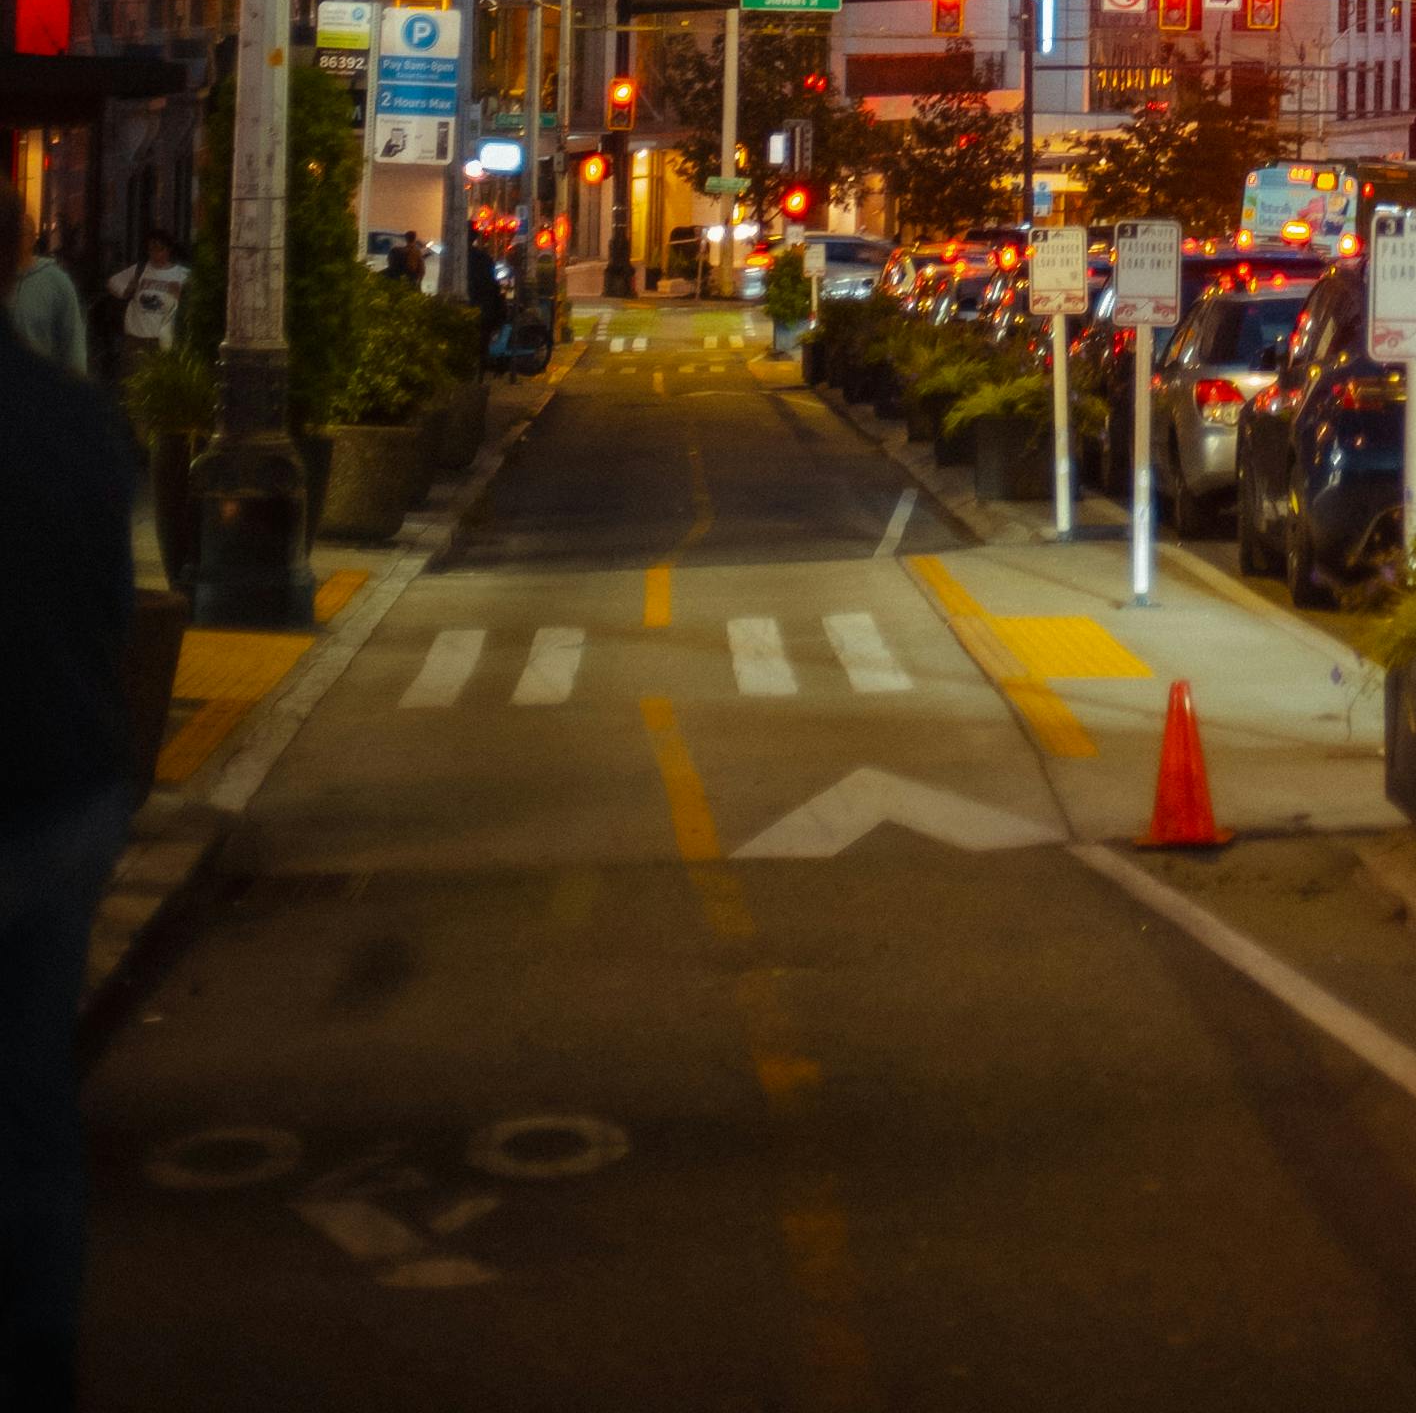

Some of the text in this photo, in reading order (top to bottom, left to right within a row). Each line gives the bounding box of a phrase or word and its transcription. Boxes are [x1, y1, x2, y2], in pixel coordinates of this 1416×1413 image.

[320, 55, 365, 70] 86392
[383, 59, 401, 71] Pay
[381, 92, 451, 110] 2 Hours Max
[1121, 243, 1174, 254] PASSENGER
[1121, 259, 1172, 270] LOAD ONLY
[1381, 265, 1416, 281] LOAD
